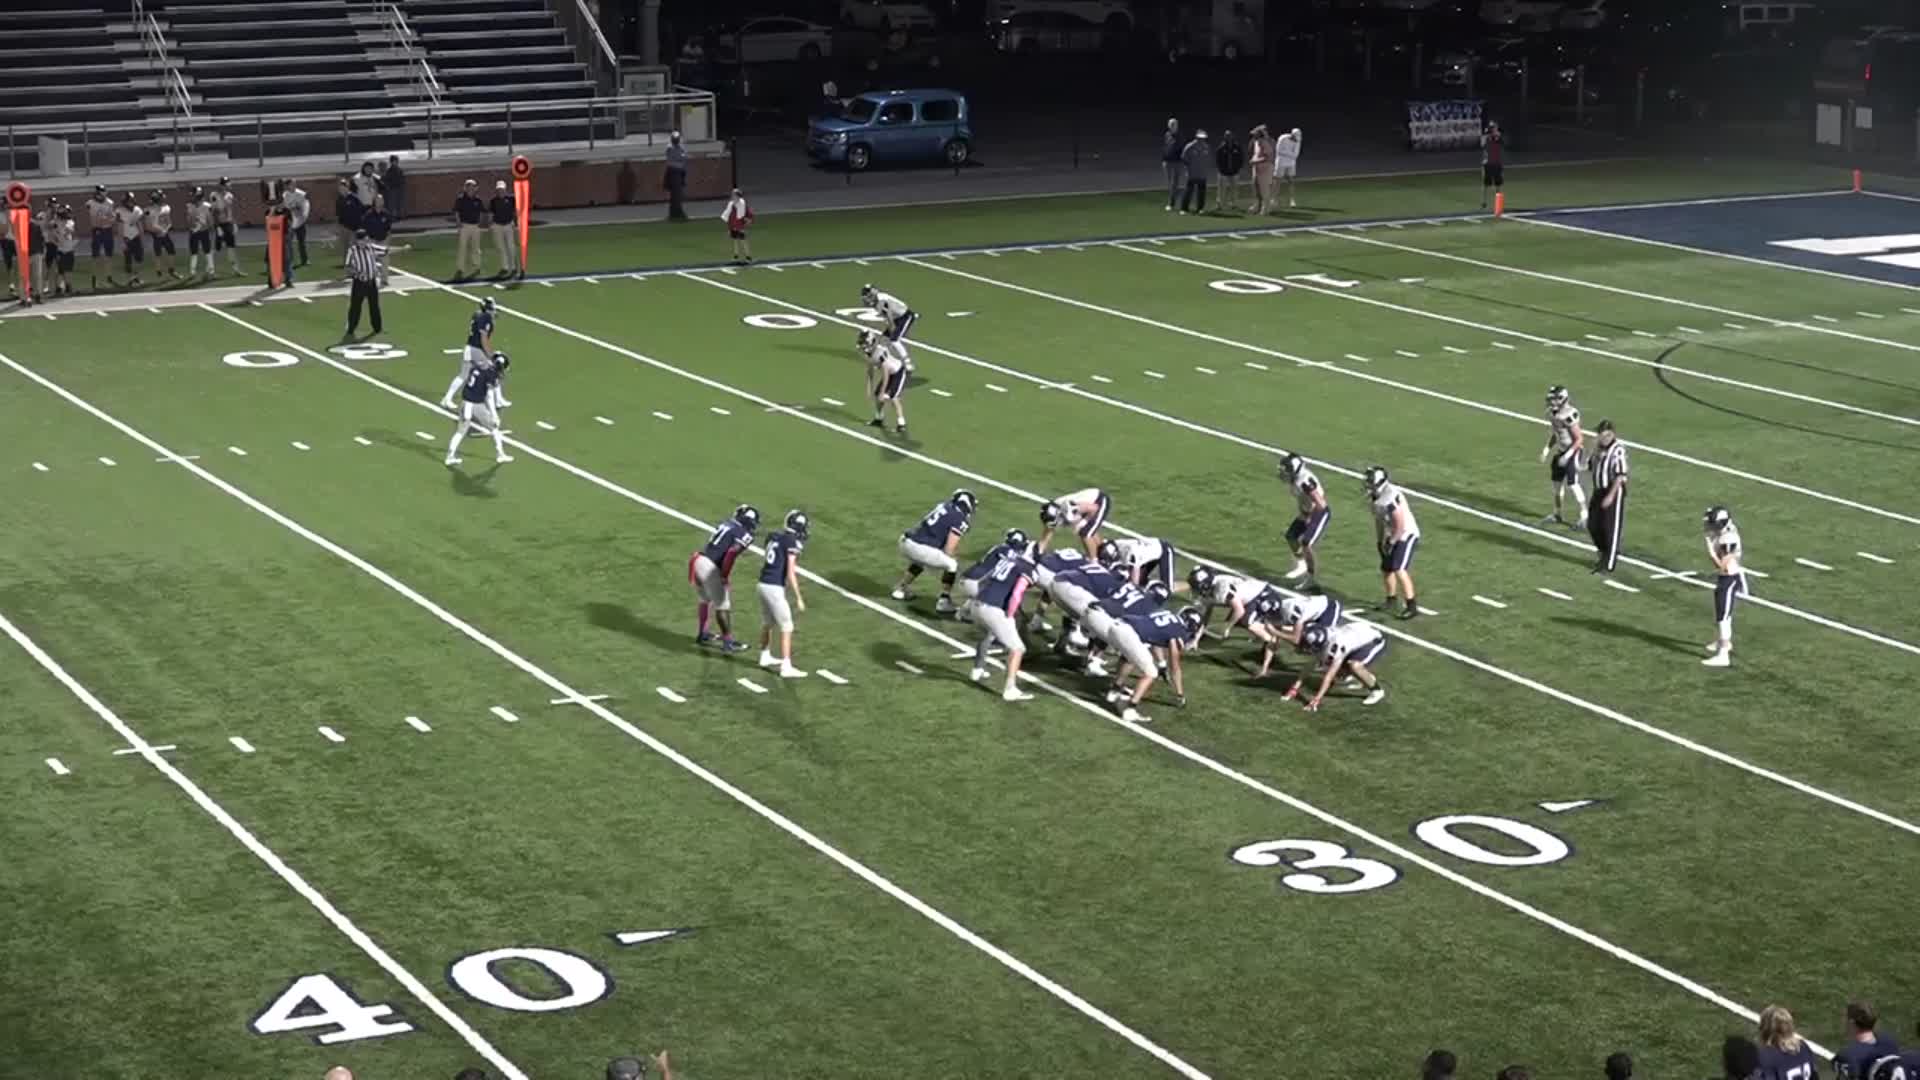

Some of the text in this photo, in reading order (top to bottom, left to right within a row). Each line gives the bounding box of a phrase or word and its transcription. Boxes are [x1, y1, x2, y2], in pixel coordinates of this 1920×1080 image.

[1112, 583, 1145, 609] 54
[1231, 814, 1571, 893] 30
[252, 947, 607, 1045] 40
